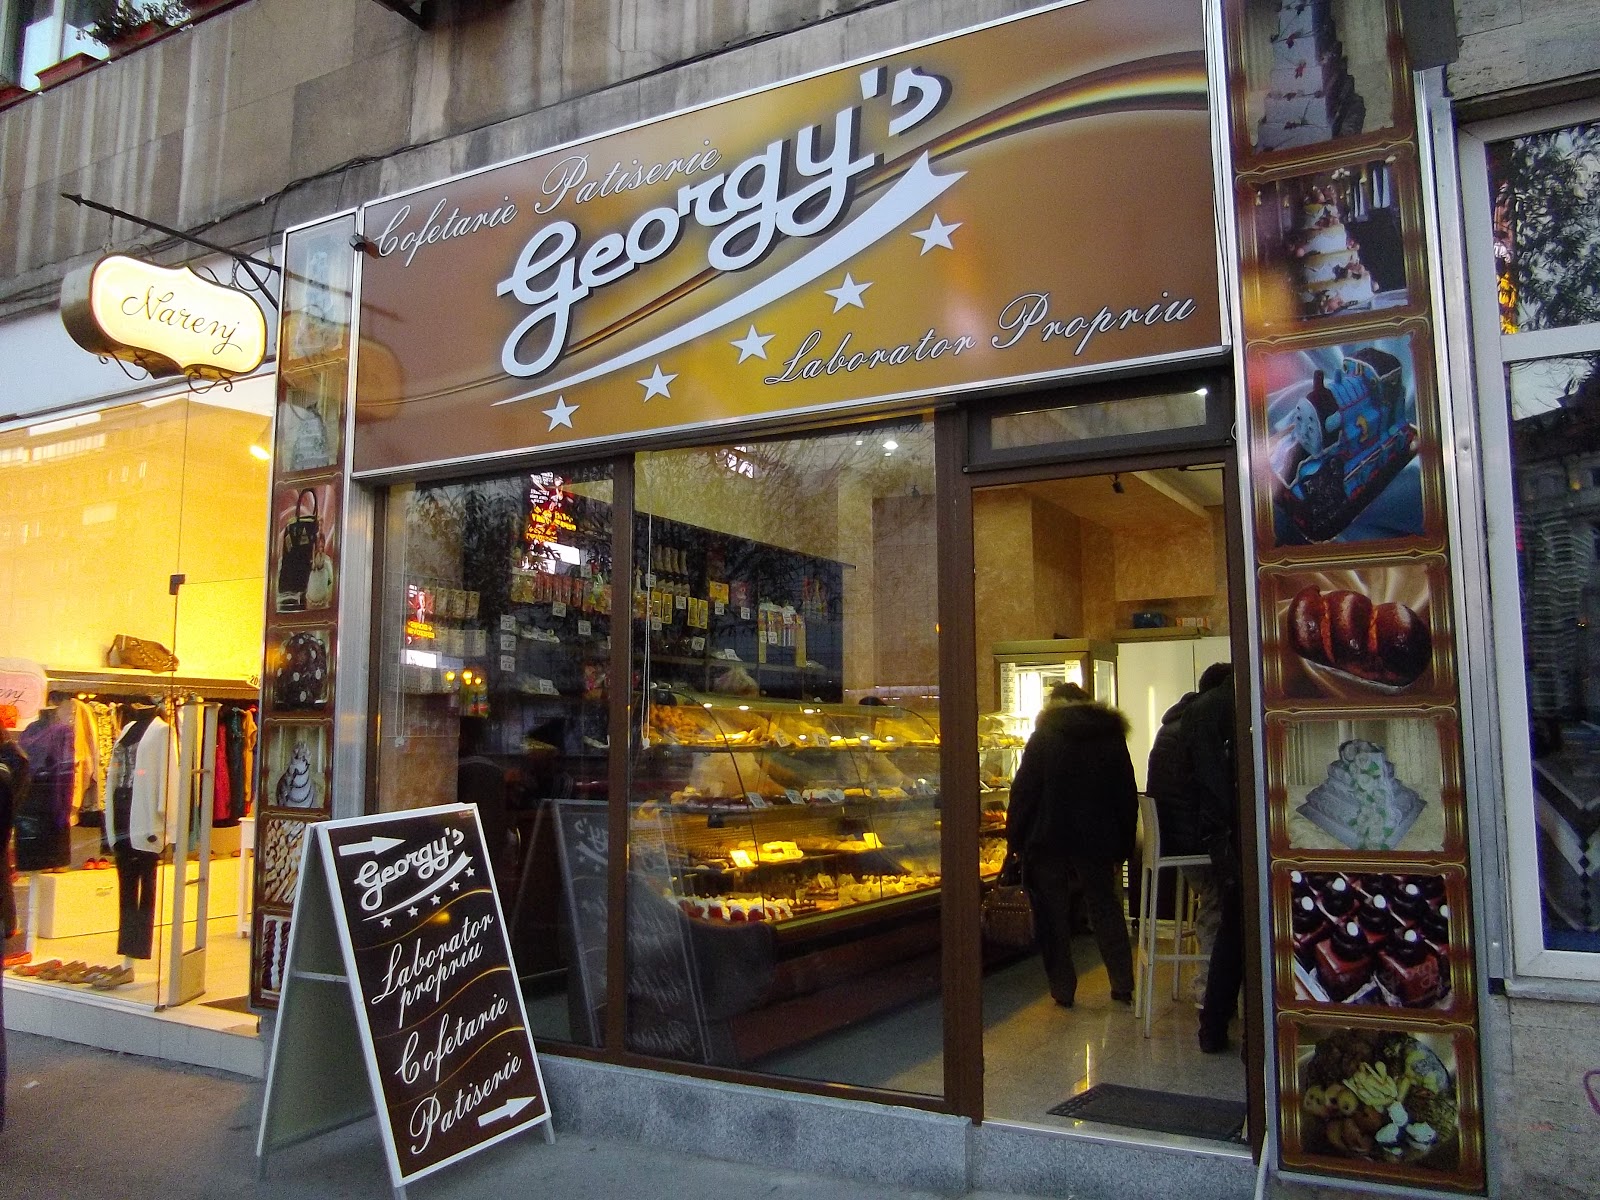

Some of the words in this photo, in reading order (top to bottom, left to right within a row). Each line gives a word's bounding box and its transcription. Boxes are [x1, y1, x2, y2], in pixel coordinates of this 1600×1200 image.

[375, 195, 519, 268] Cofetarie
[534, 139, 723, 215] Patiserie
[496, 66, 943, 379] Georgy's
[121, 285, 243, 356] Narenj
[763, 329, 976, 386] Laborator
[990, 291, 1197, 357] Propriu
[353, 826, 465, 911] Georgy's
[370, 914, 494, 1006] Laborator
[398, 941, 483, 1030] propriu
[394, 992, 508, 1086] Cofetarie
[409, 1051, 523, 1156] Patiserie
